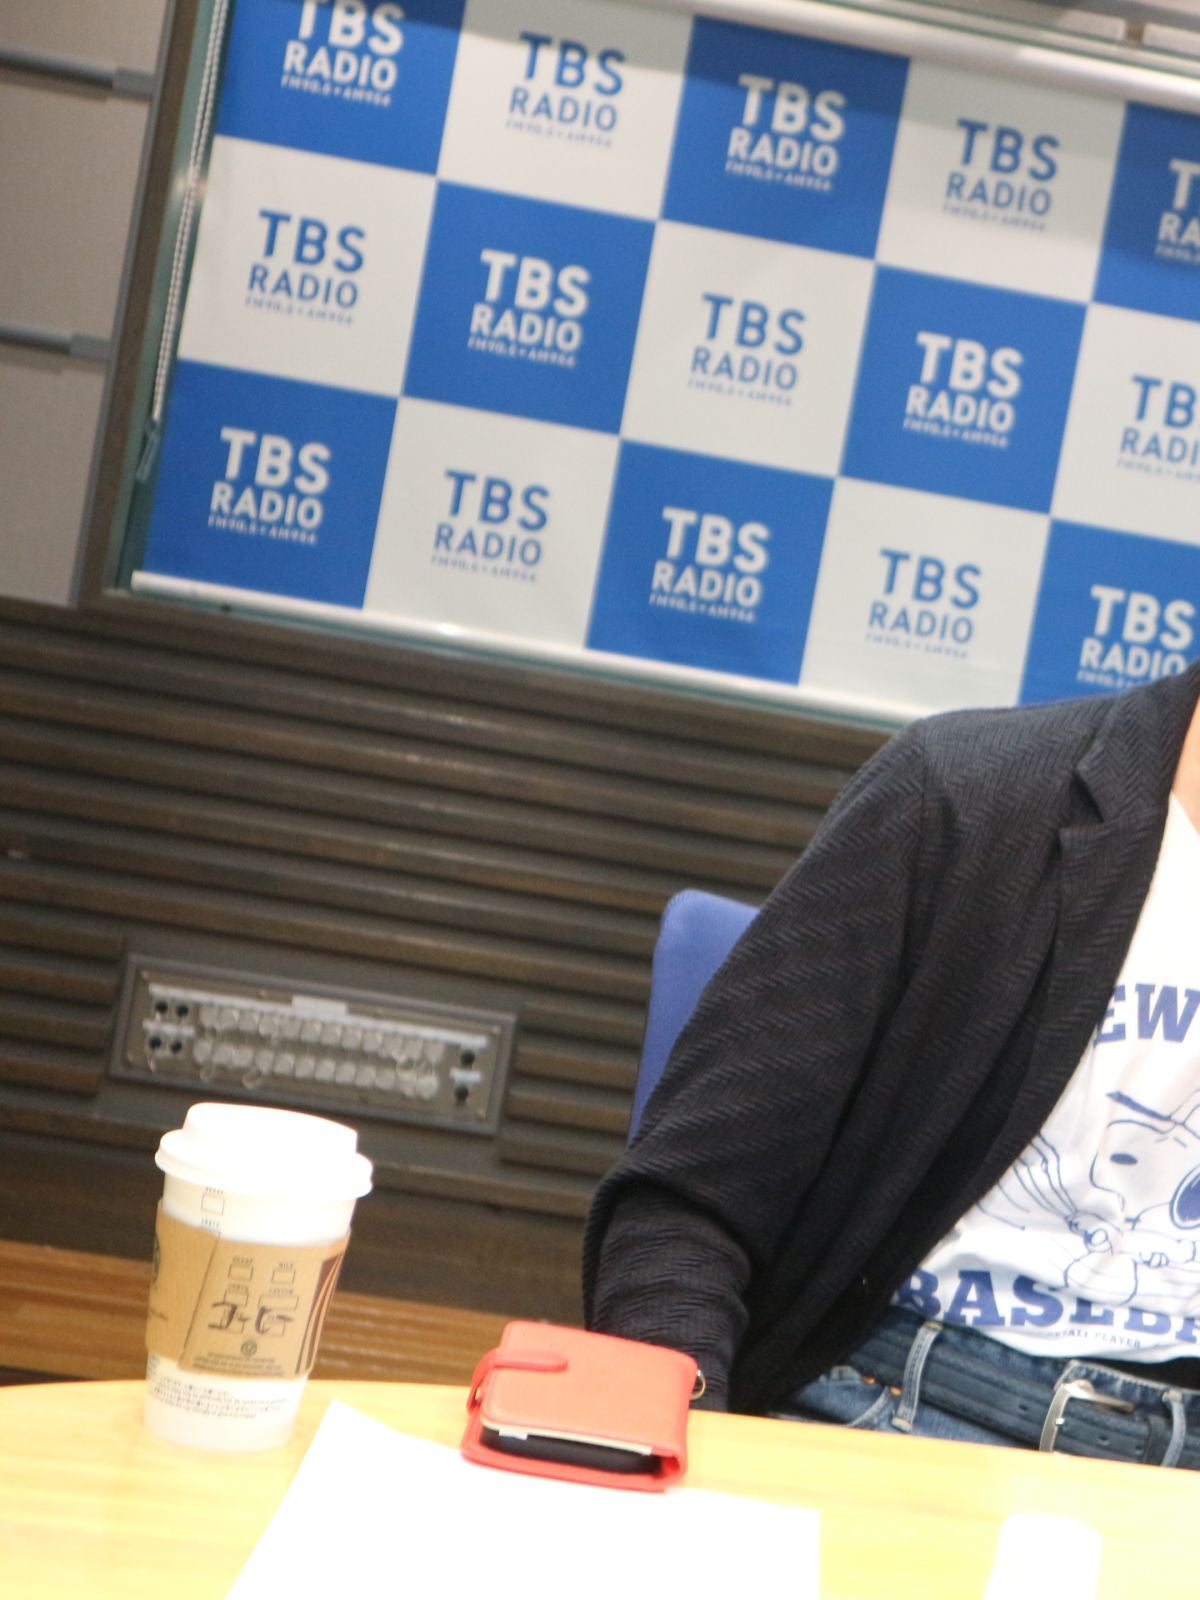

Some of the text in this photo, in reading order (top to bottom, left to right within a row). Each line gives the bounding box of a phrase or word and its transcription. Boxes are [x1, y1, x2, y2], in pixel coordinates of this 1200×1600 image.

[299, 0, 404, 56] TBS
[284, 41, 397, 91] RADIO
[518, 30, 626, 97] TBS
[509, 86, 617, 132] RADIO
[739, 74, 845, 142] TBS
[728, 127, 838, 176] RADIO
[957, 118, 1060, 182] TBS
[946, 172, 1052, 216] RADIO
[259, 209, 366, 275] TBS
[248, 263, 359, 309] RADIO
[481, 249, 590, 318] TBS
[470, 303, 582, 352] RADIO
[702, 293, 806, 357] TBS
[691, 346, 798, 391] RADIO
[916, 332, 1023, 399] TBS
[906, 384, 1015, 433] RADIO
[221, 427, 331, 495] TBS
[210, 481, 323, 529] RADIO
[445, 469, 550, 533] TBS
[434, 523, 543, 567] RADIO
[662, 506, 770, 574] TBS
[651, 561, 762, 608] RADIO
[879, 548, 982, 611] TBS
[868, 602, 974, 645] RADIO
[1091, 584, 1195, 651] TBS
[1080, 637, 1187, 680] RADIO
